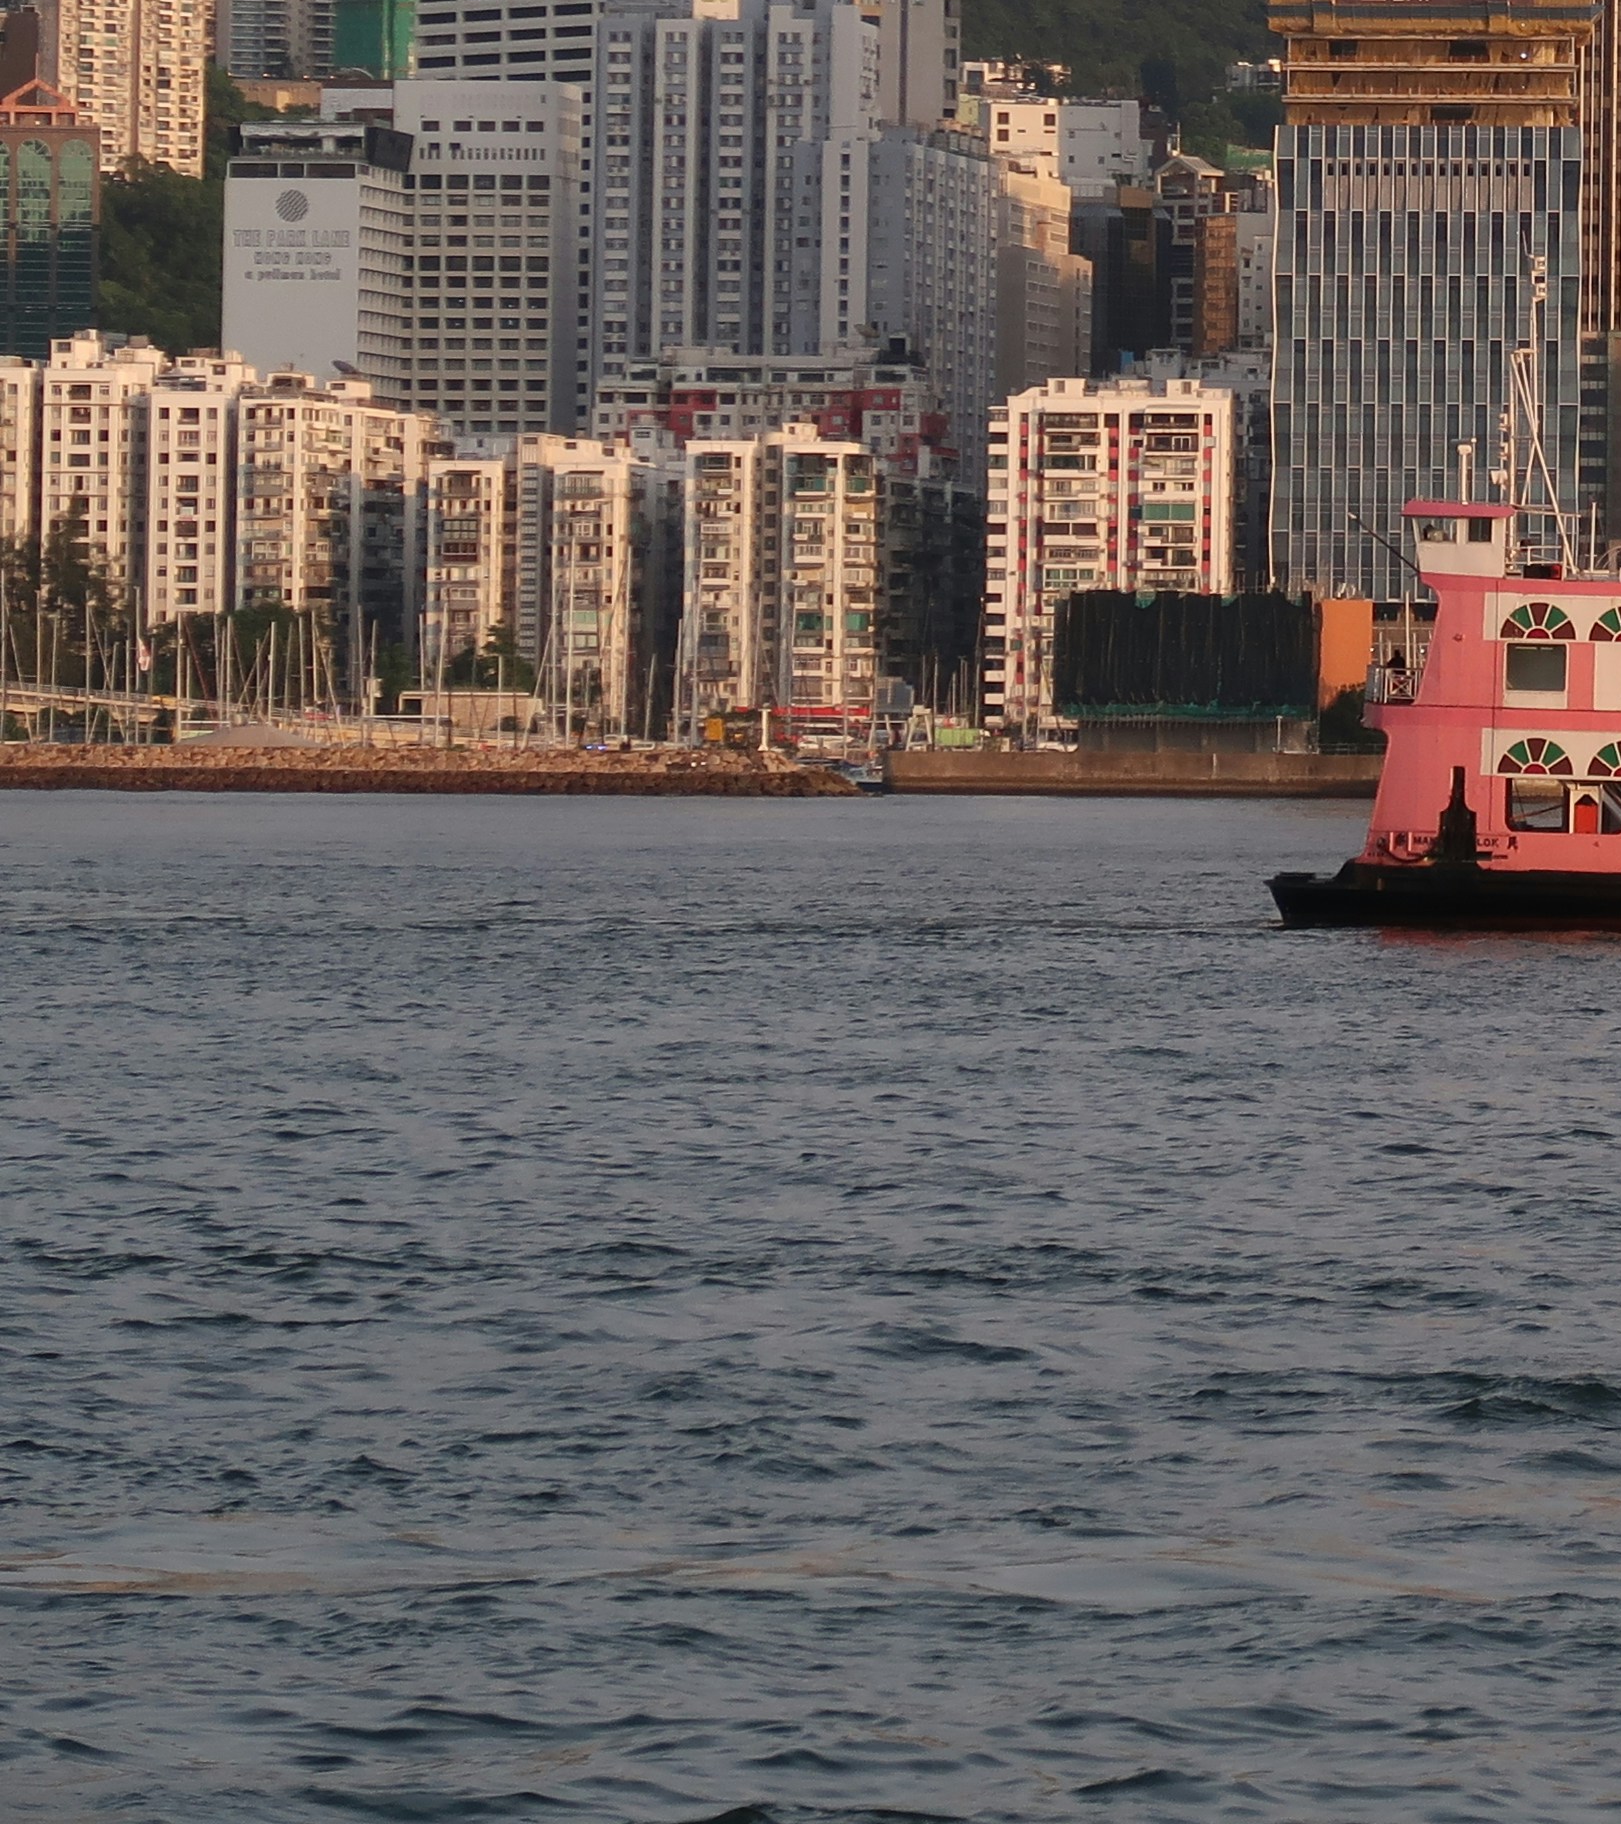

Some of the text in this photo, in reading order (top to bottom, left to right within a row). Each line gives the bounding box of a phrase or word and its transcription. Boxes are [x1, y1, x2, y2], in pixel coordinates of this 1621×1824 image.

[233, 229, 350, 248] THE PARK LANE
